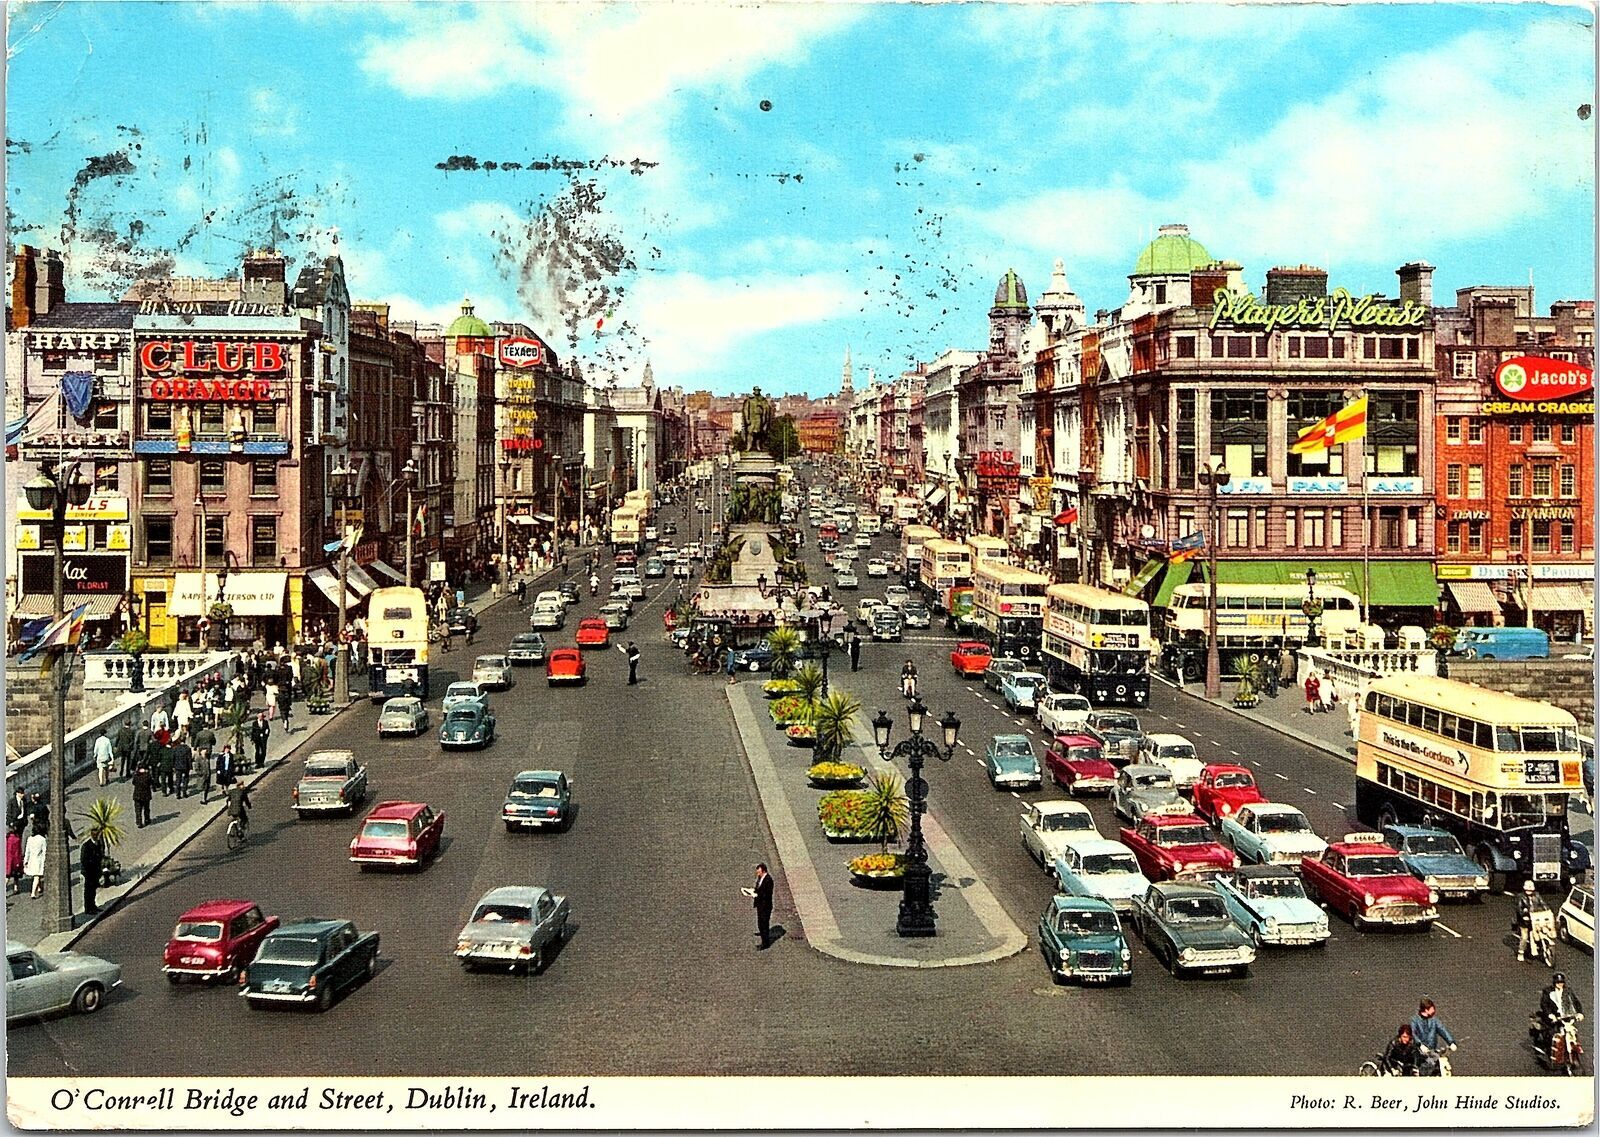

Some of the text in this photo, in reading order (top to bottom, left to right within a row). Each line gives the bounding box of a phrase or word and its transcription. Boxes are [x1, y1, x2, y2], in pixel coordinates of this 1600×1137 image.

[1329, 287, 1425, 331] Please
[32, 333, 121, 351] HARP
[142, 341, 285, 372] CLUB
[504, 346, 538, 357] TEXACO
[1530, 370, 1588, 385] Jacob's
[150, 379, 272, 401] ORANGE
[515, 395, 530, 404] THE
[1482, 402, 1534, 414] CREAM
[31, 433, 122, 446] LAGER
[1292, 481, 1345, 492] PAN
[1372, 482, 1415, 492] AM
[1383, 731, 1395, 746] This
[1401, 739, 1410, 751] the
